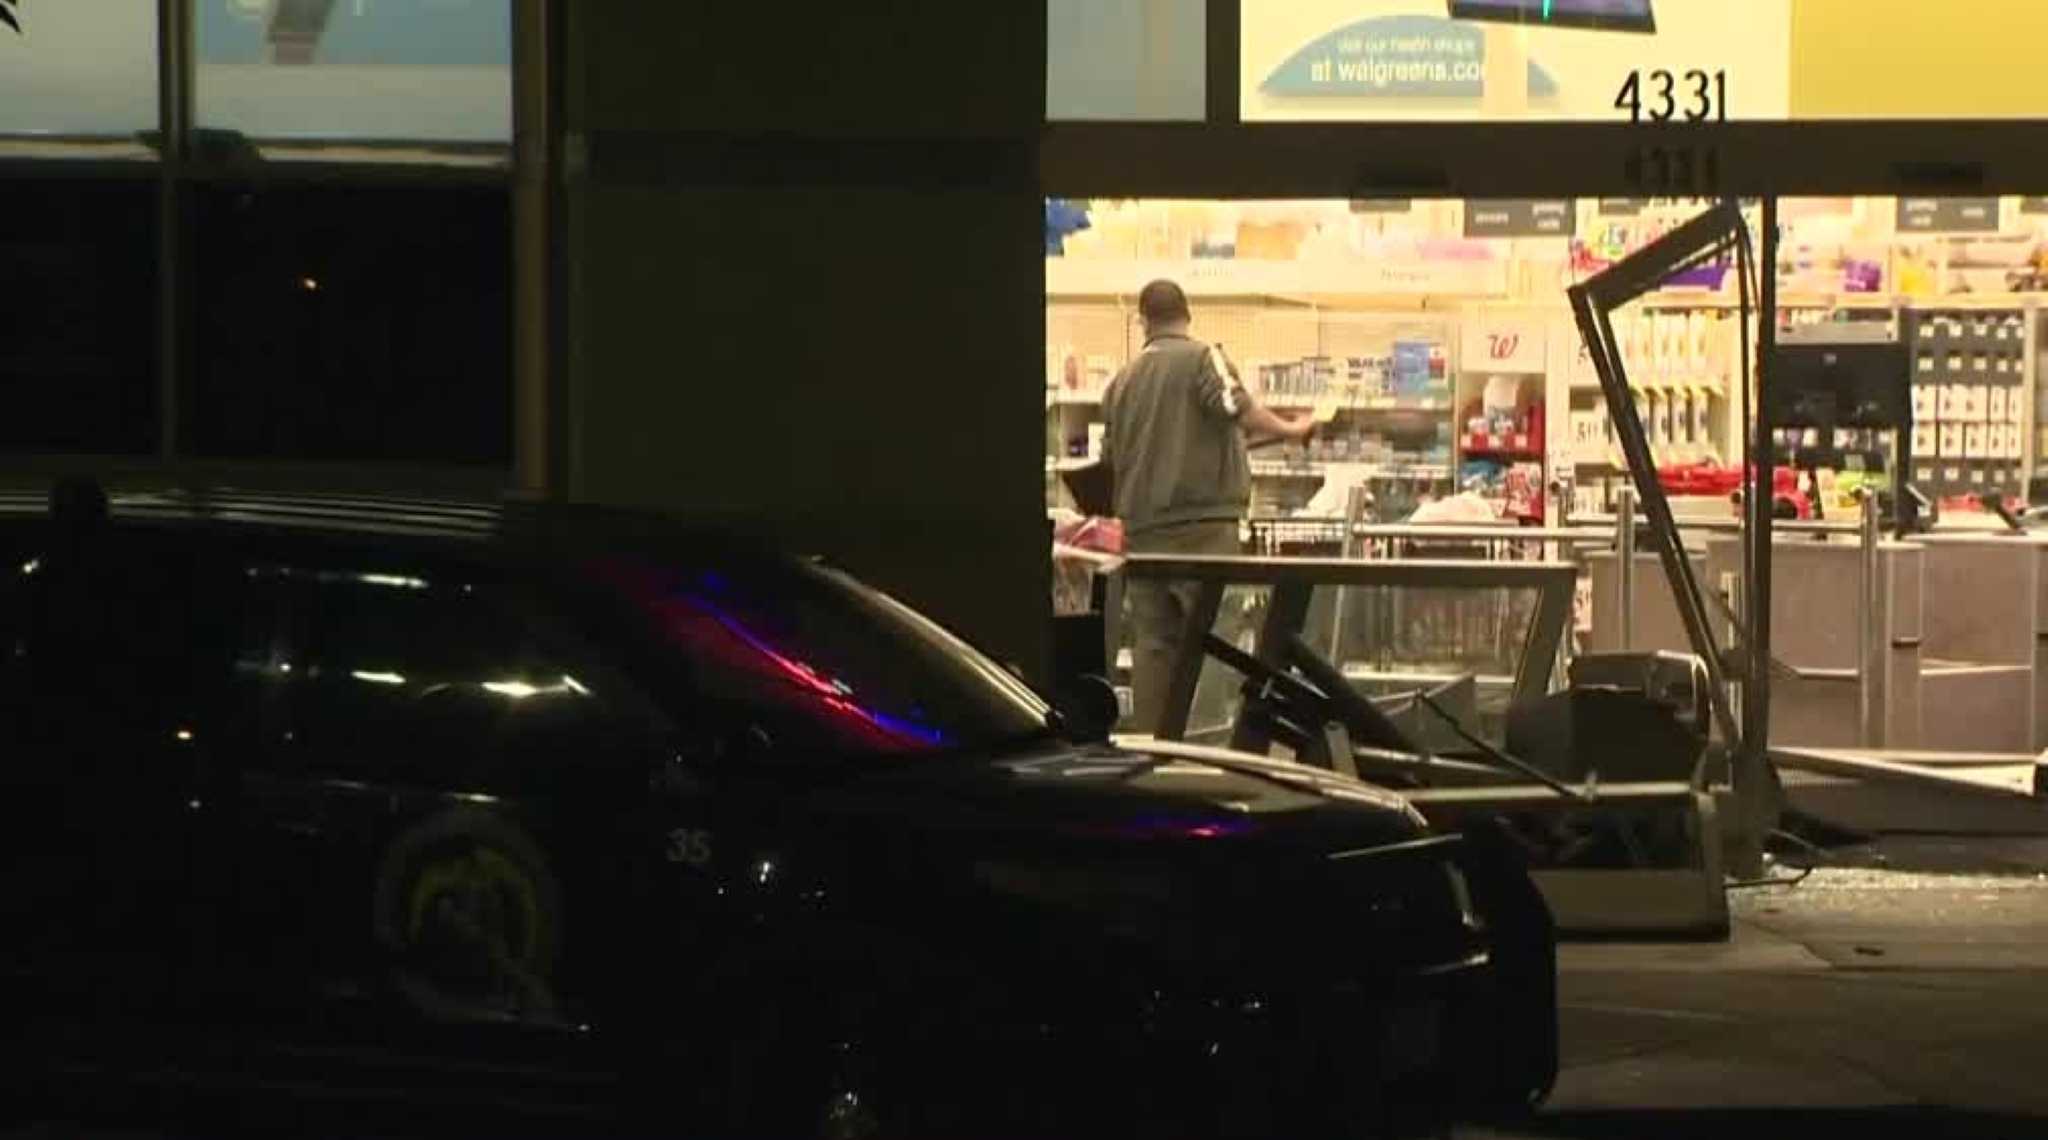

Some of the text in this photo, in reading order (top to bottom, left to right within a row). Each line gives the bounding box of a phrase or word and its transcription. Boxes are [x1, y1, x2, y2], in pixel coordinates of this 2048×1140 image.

[1312, 57, 1486, 88] at walgreens.co
[1614, 69, 1726, 126] 4331
[664, 826, 713, 863] 35
